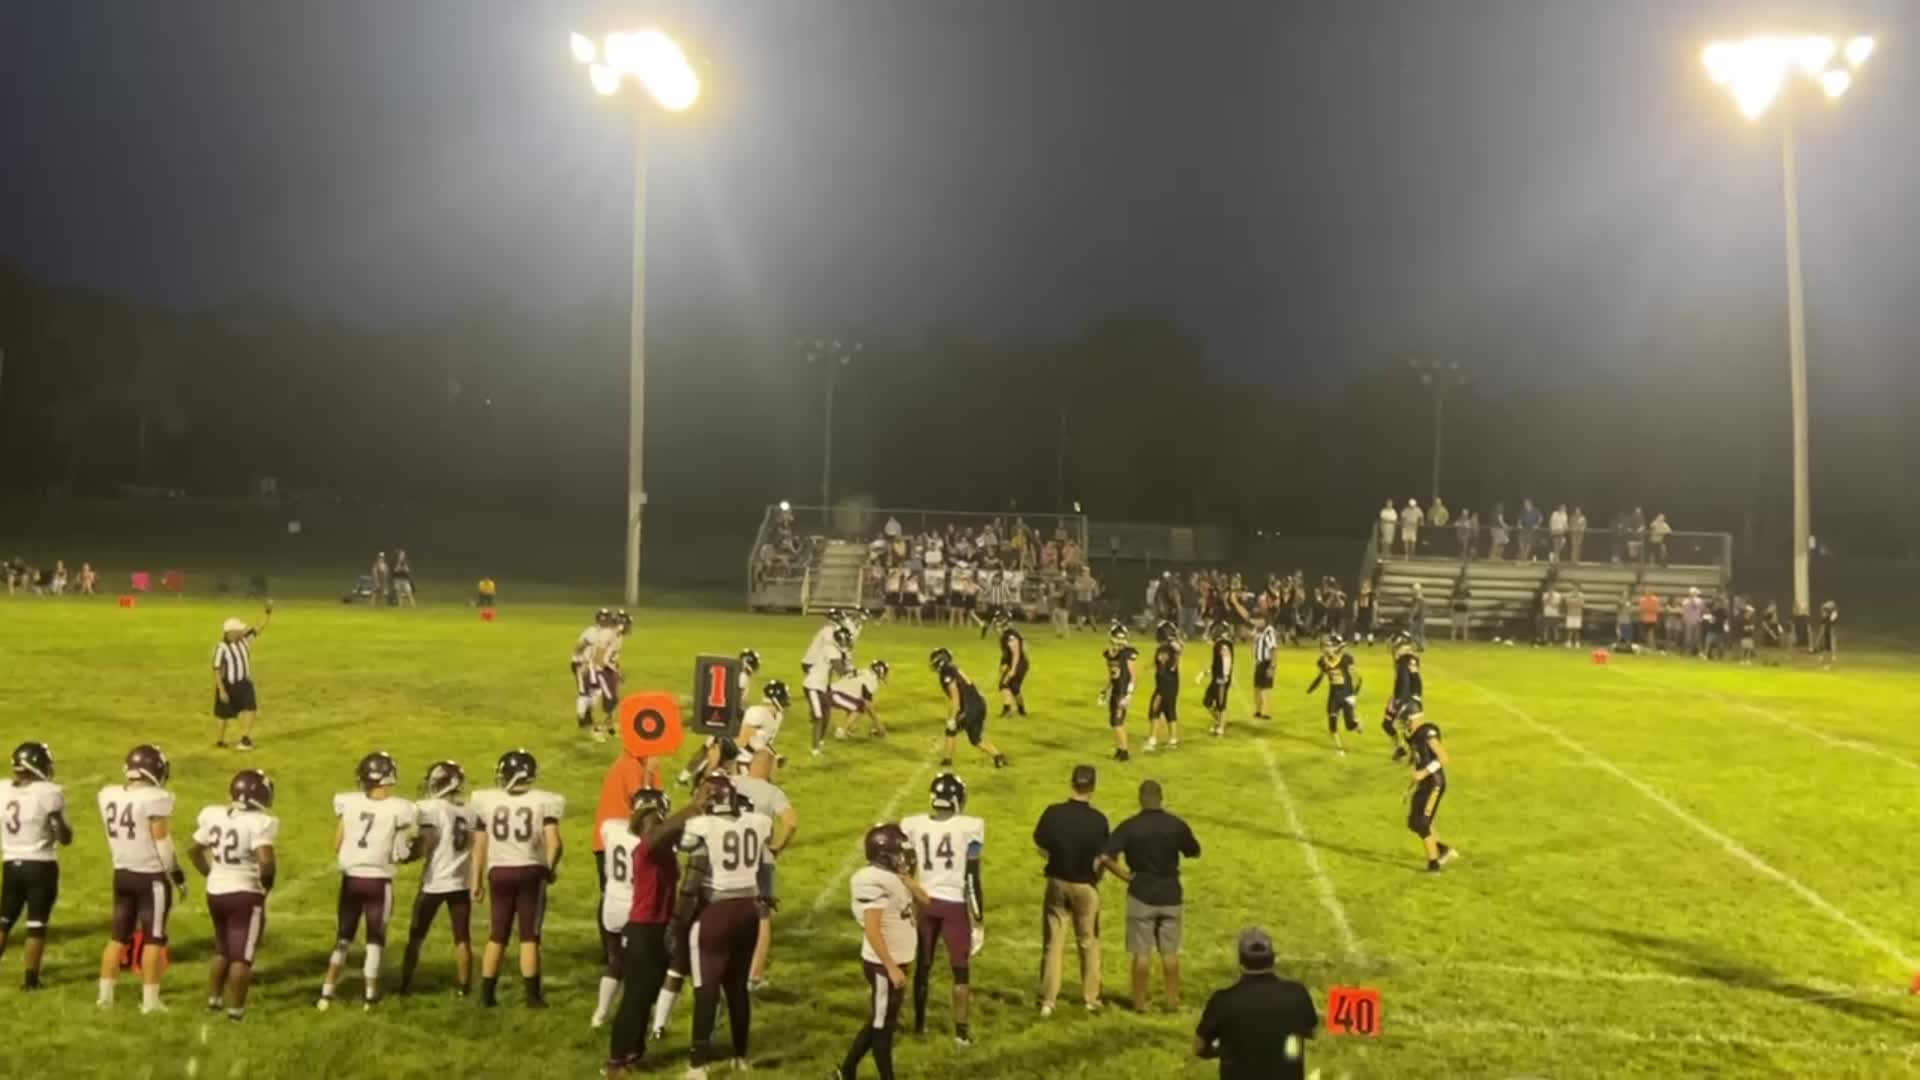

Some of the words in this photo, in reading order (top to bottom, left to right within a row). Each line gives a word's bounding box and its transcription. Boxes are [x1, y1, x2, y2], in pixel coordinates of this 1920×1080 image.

[708, 664, 726, 707] 1
[6, 800, 21, 835] 3
[106, 802, 136, 840] 24
[357, 811, 376, 848] 7
[492, 805, 533, 842] 83
[208, 825, 242, 865] 22
[722, 828, 758, 871] 90
[921, 832, 954, 870] 14
[1334, 996, 1373, 1034] 40
